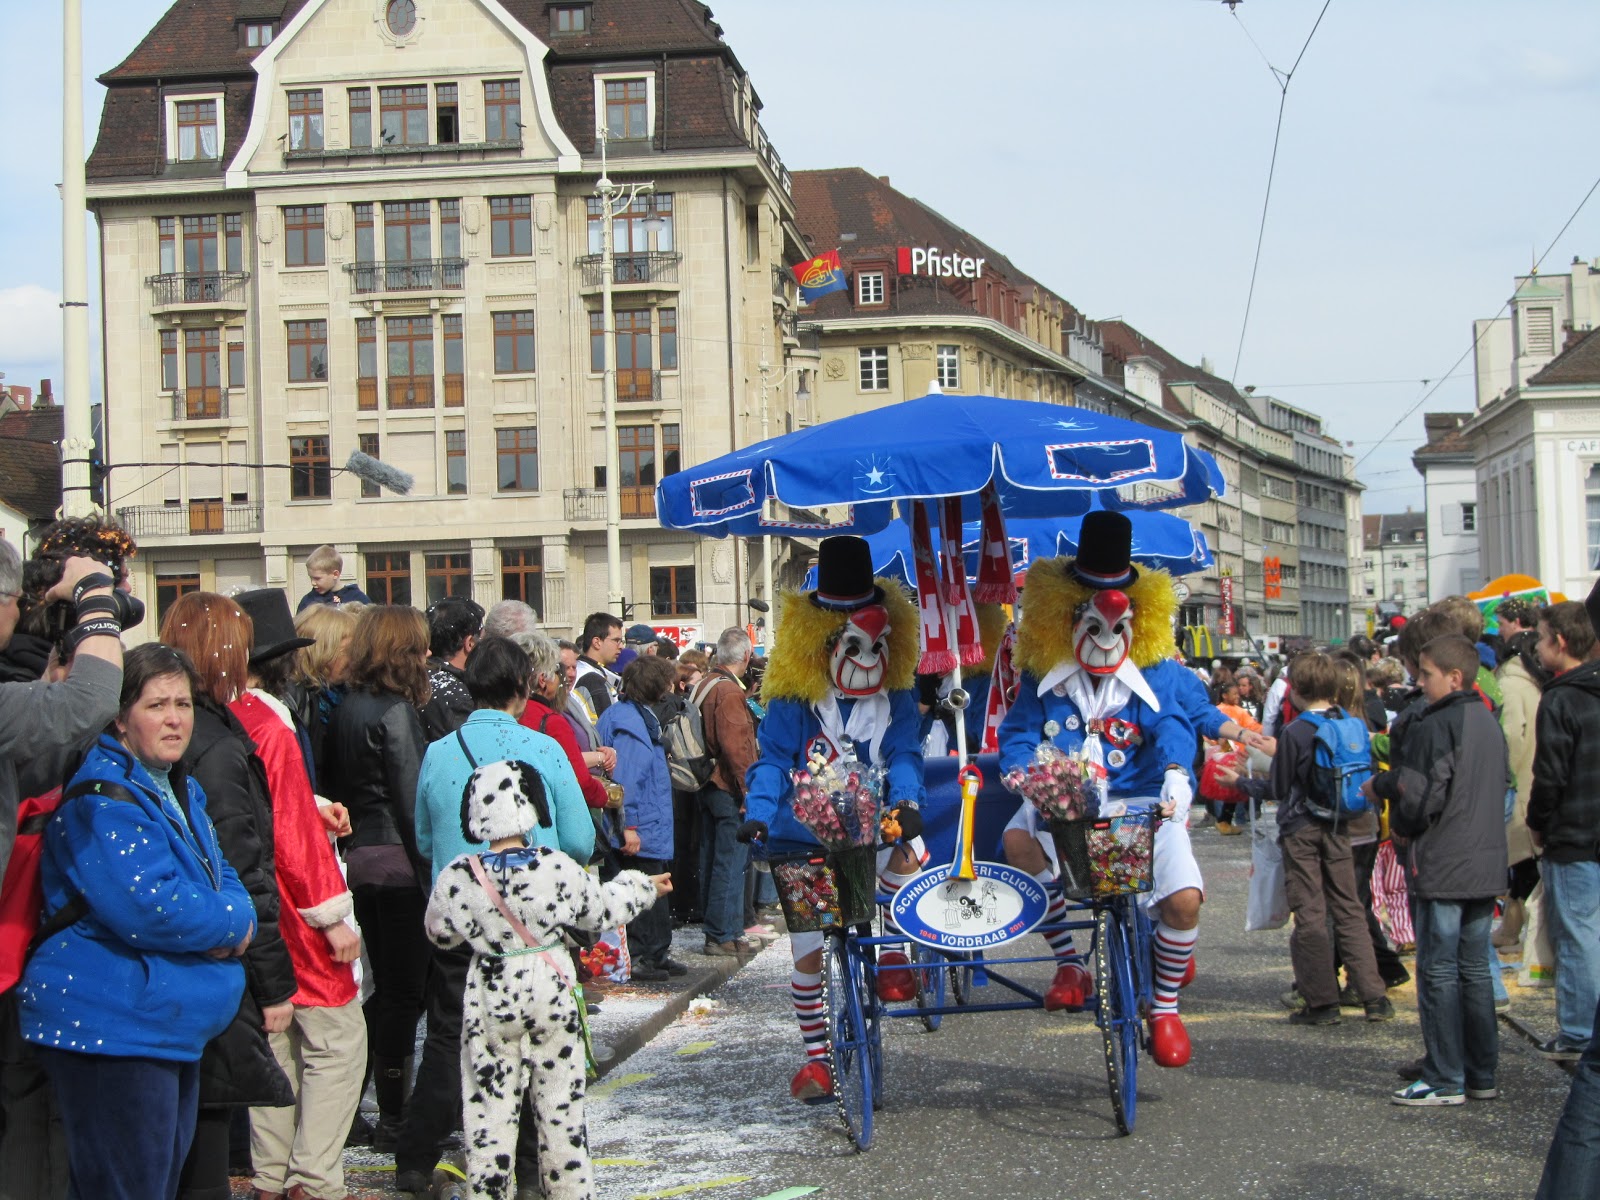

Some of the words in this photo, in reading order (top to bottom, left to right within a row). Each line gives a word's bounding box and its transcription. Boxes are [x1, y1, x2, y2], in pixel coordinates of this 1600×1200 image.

[912, 247, 985, 278] Pfister
[1567, 441, 1600, 452] CAF
[83, 622, 120, 632] DIGITAL
[940, 930, 1008, 947] VORDRAAB
[1009, 920, 1025, 933] 2011
